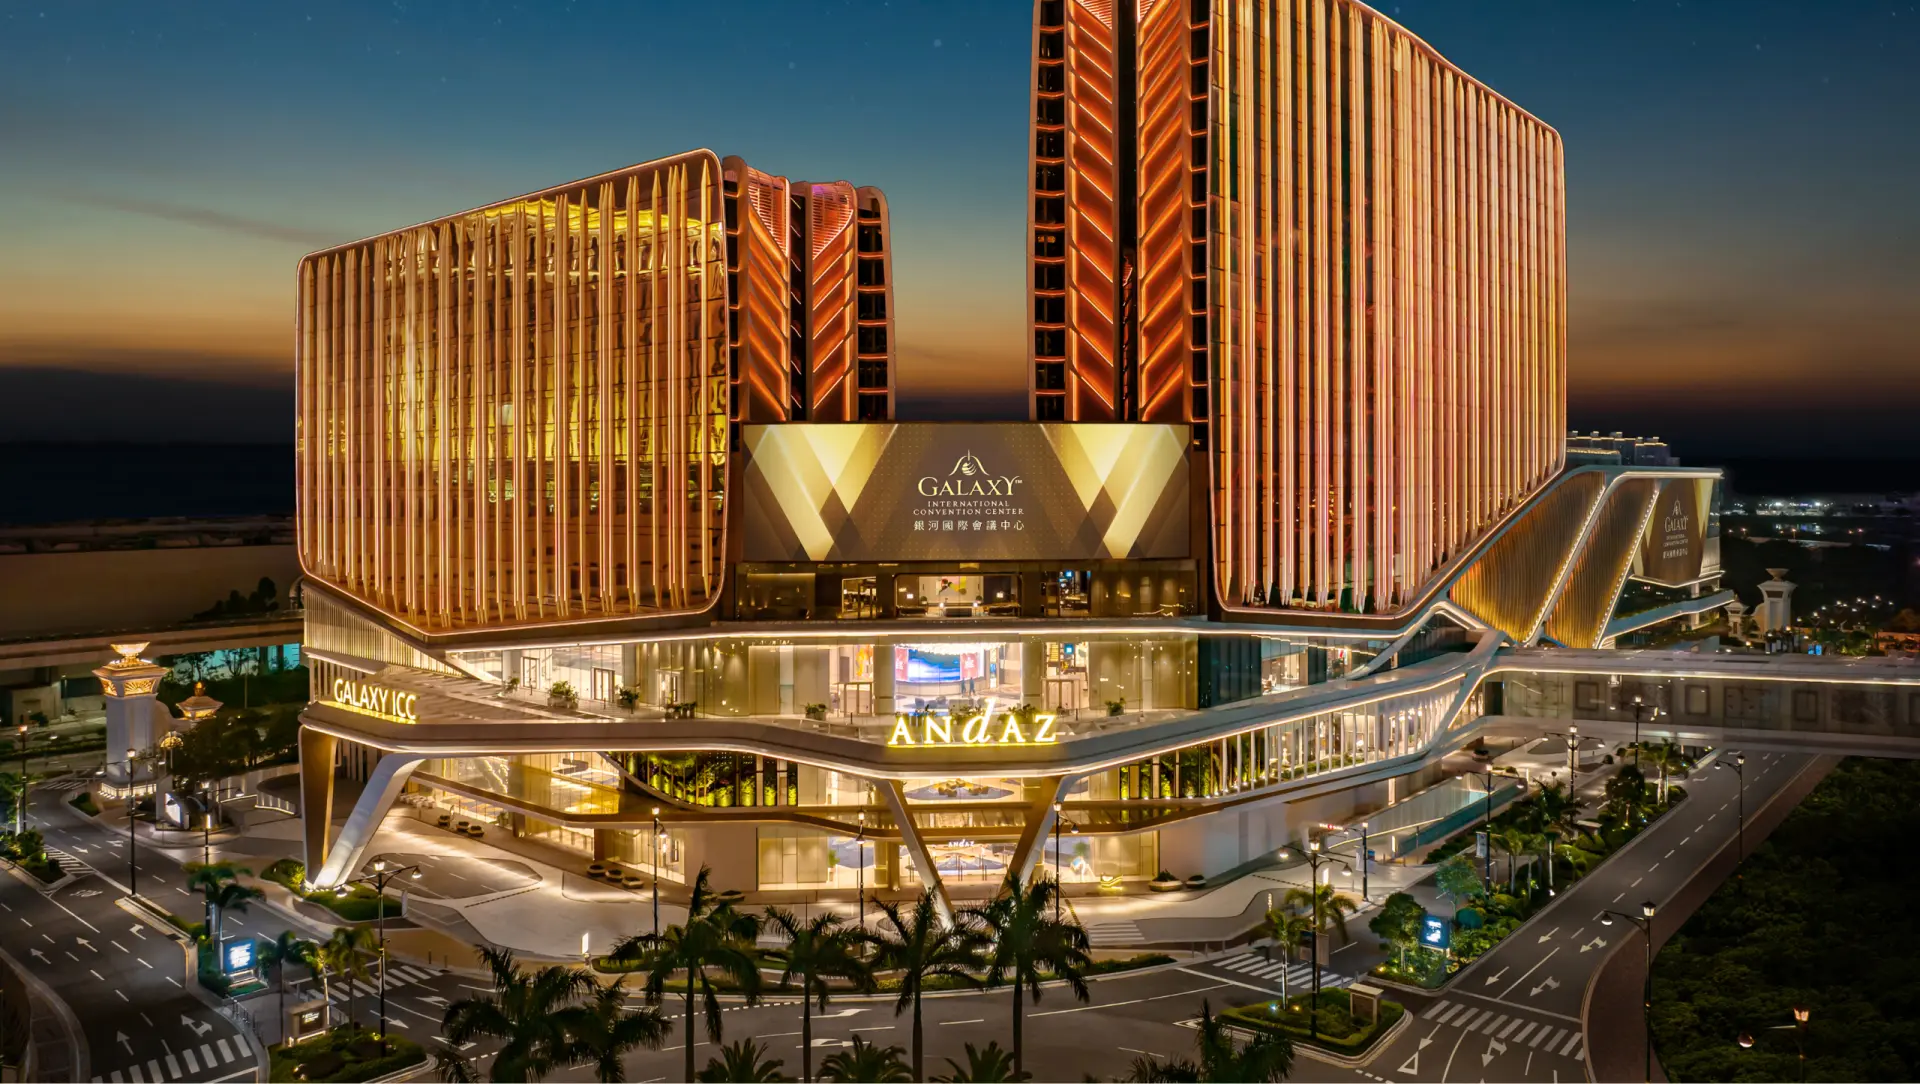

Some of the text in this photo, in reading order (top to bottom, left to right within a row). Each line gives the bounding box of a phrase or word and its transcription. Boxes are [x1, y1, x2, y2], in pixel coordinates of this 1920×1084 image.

[927, 500, 1010, 508] INTERNATIONAL
[913, 508, 981, 516] CONVENTION
[913, 520, 1025, 531] 銀河國際會議中心
[333, 678, 417, 720] GALAXY ICC
